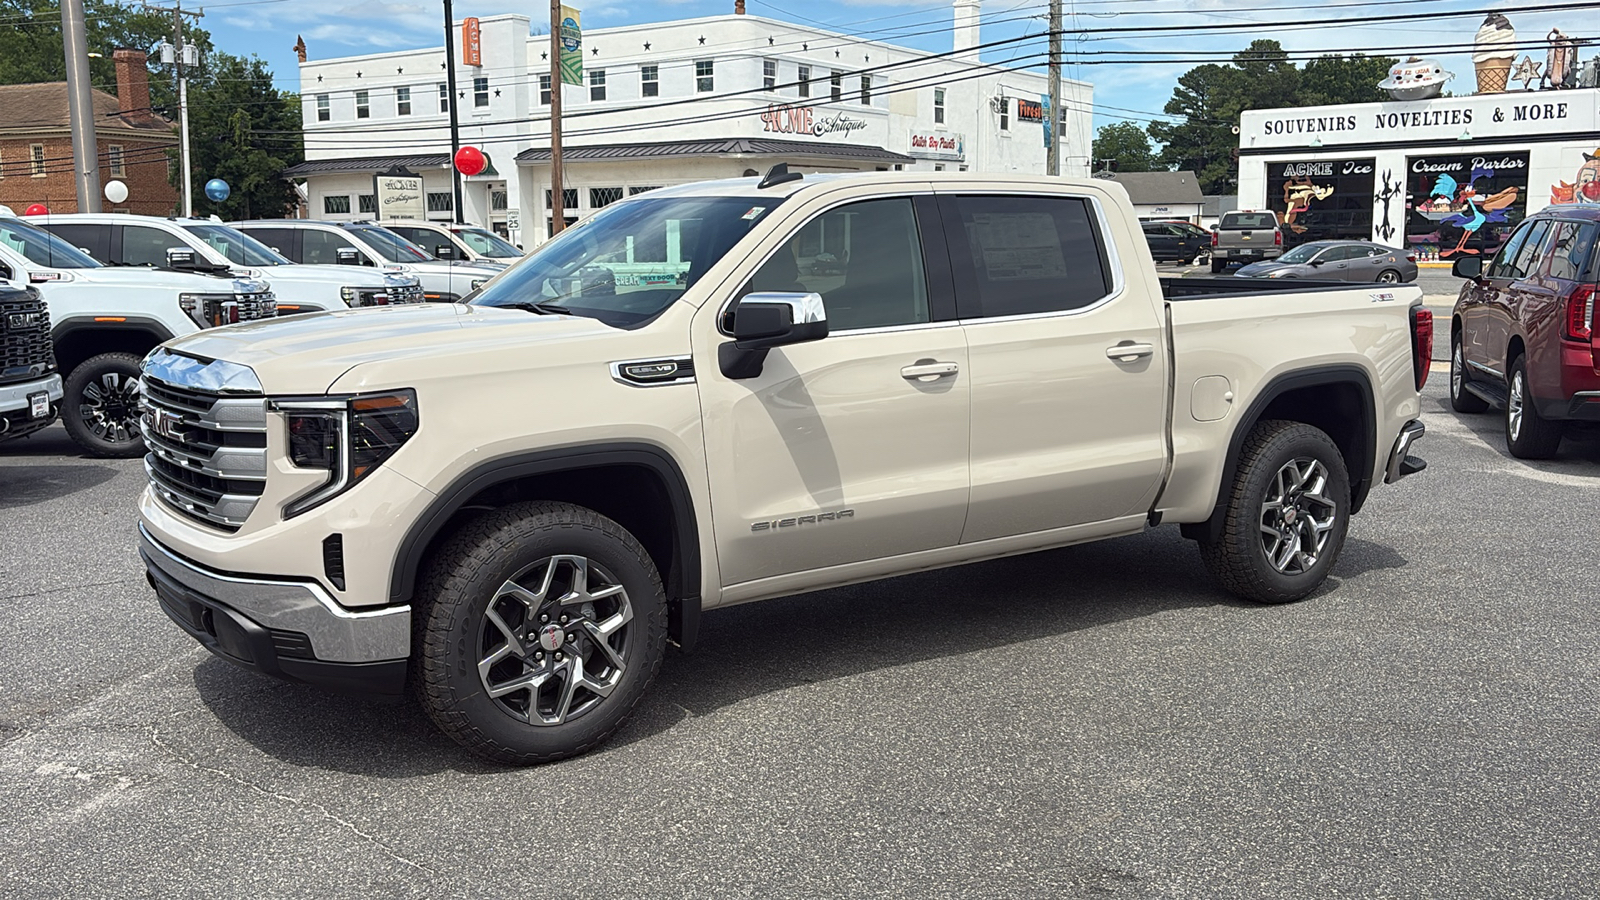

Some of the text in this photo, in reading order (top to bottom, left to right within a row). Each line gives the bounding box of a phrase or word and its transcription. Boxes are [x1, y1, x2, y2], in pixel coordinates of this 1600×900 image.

[470, 20, 479, 62] ACME
[1018, 99, 1042, 118] Firest
[761, 103, 867, 138] ACME Antiques
[1264, 103, 1568, 135] SOUVENIRS NOVELTIES & MORE
[912, 134, 955, 151] Dutch Boy Paints
[1283, 156, 1526, 177] ACME Ice Cream Parlor
[385, 180, 418, 190] ACME
[508, 219, 519, 228] 25
[615, 276, 640, 286] CREAM
[751, 509, 854, 532] SIERRA
